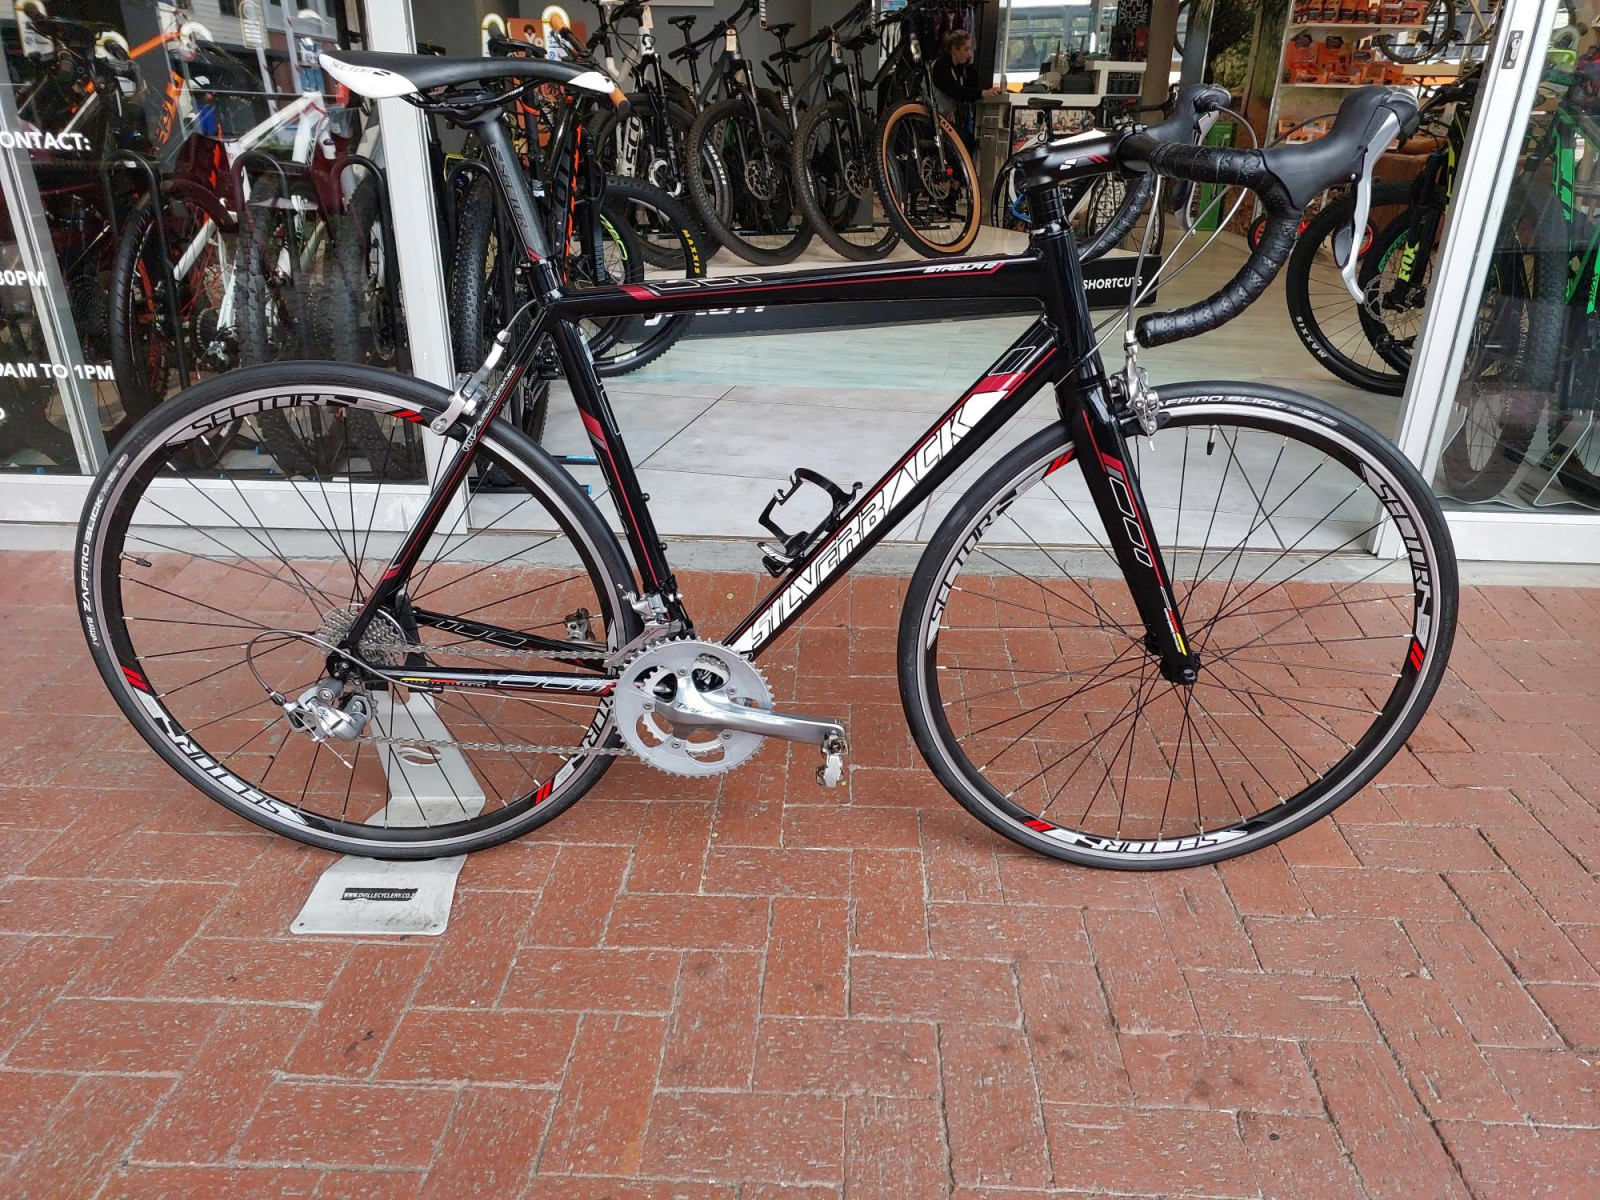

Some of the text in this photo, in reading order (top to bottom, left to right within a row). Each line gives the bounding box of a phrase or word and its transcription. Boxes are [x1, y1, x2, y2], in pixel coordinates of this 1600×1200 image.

[707, 145, 727, 186] MAXXIS
[500, 164, 530, 229] SECTOR
[682, 229, 702, 275] MAXXIS
[1397, 241, 1420, 283] FOX
[1296, 316, 1329, 358] MAXXIS
[40, 364, 68, 379] TO
[74, 364, 115, 380] 1PM
[191, 394, 321, 432] SECTOR
[1230, 395, 1286, 410] SLICK
[85, 497, 104, 544] SLICK
[751, 403, 976, 649] SILVERBACK
[1379, 482, 1432, 587] SECTOR
[81, 543, 93, 613] ZAFFIRO
[931, 513, 995, 623] SECTOR
[176, 741, 282, 815] SECTOR
[1102, 836, 1218, 853] SECTOR
